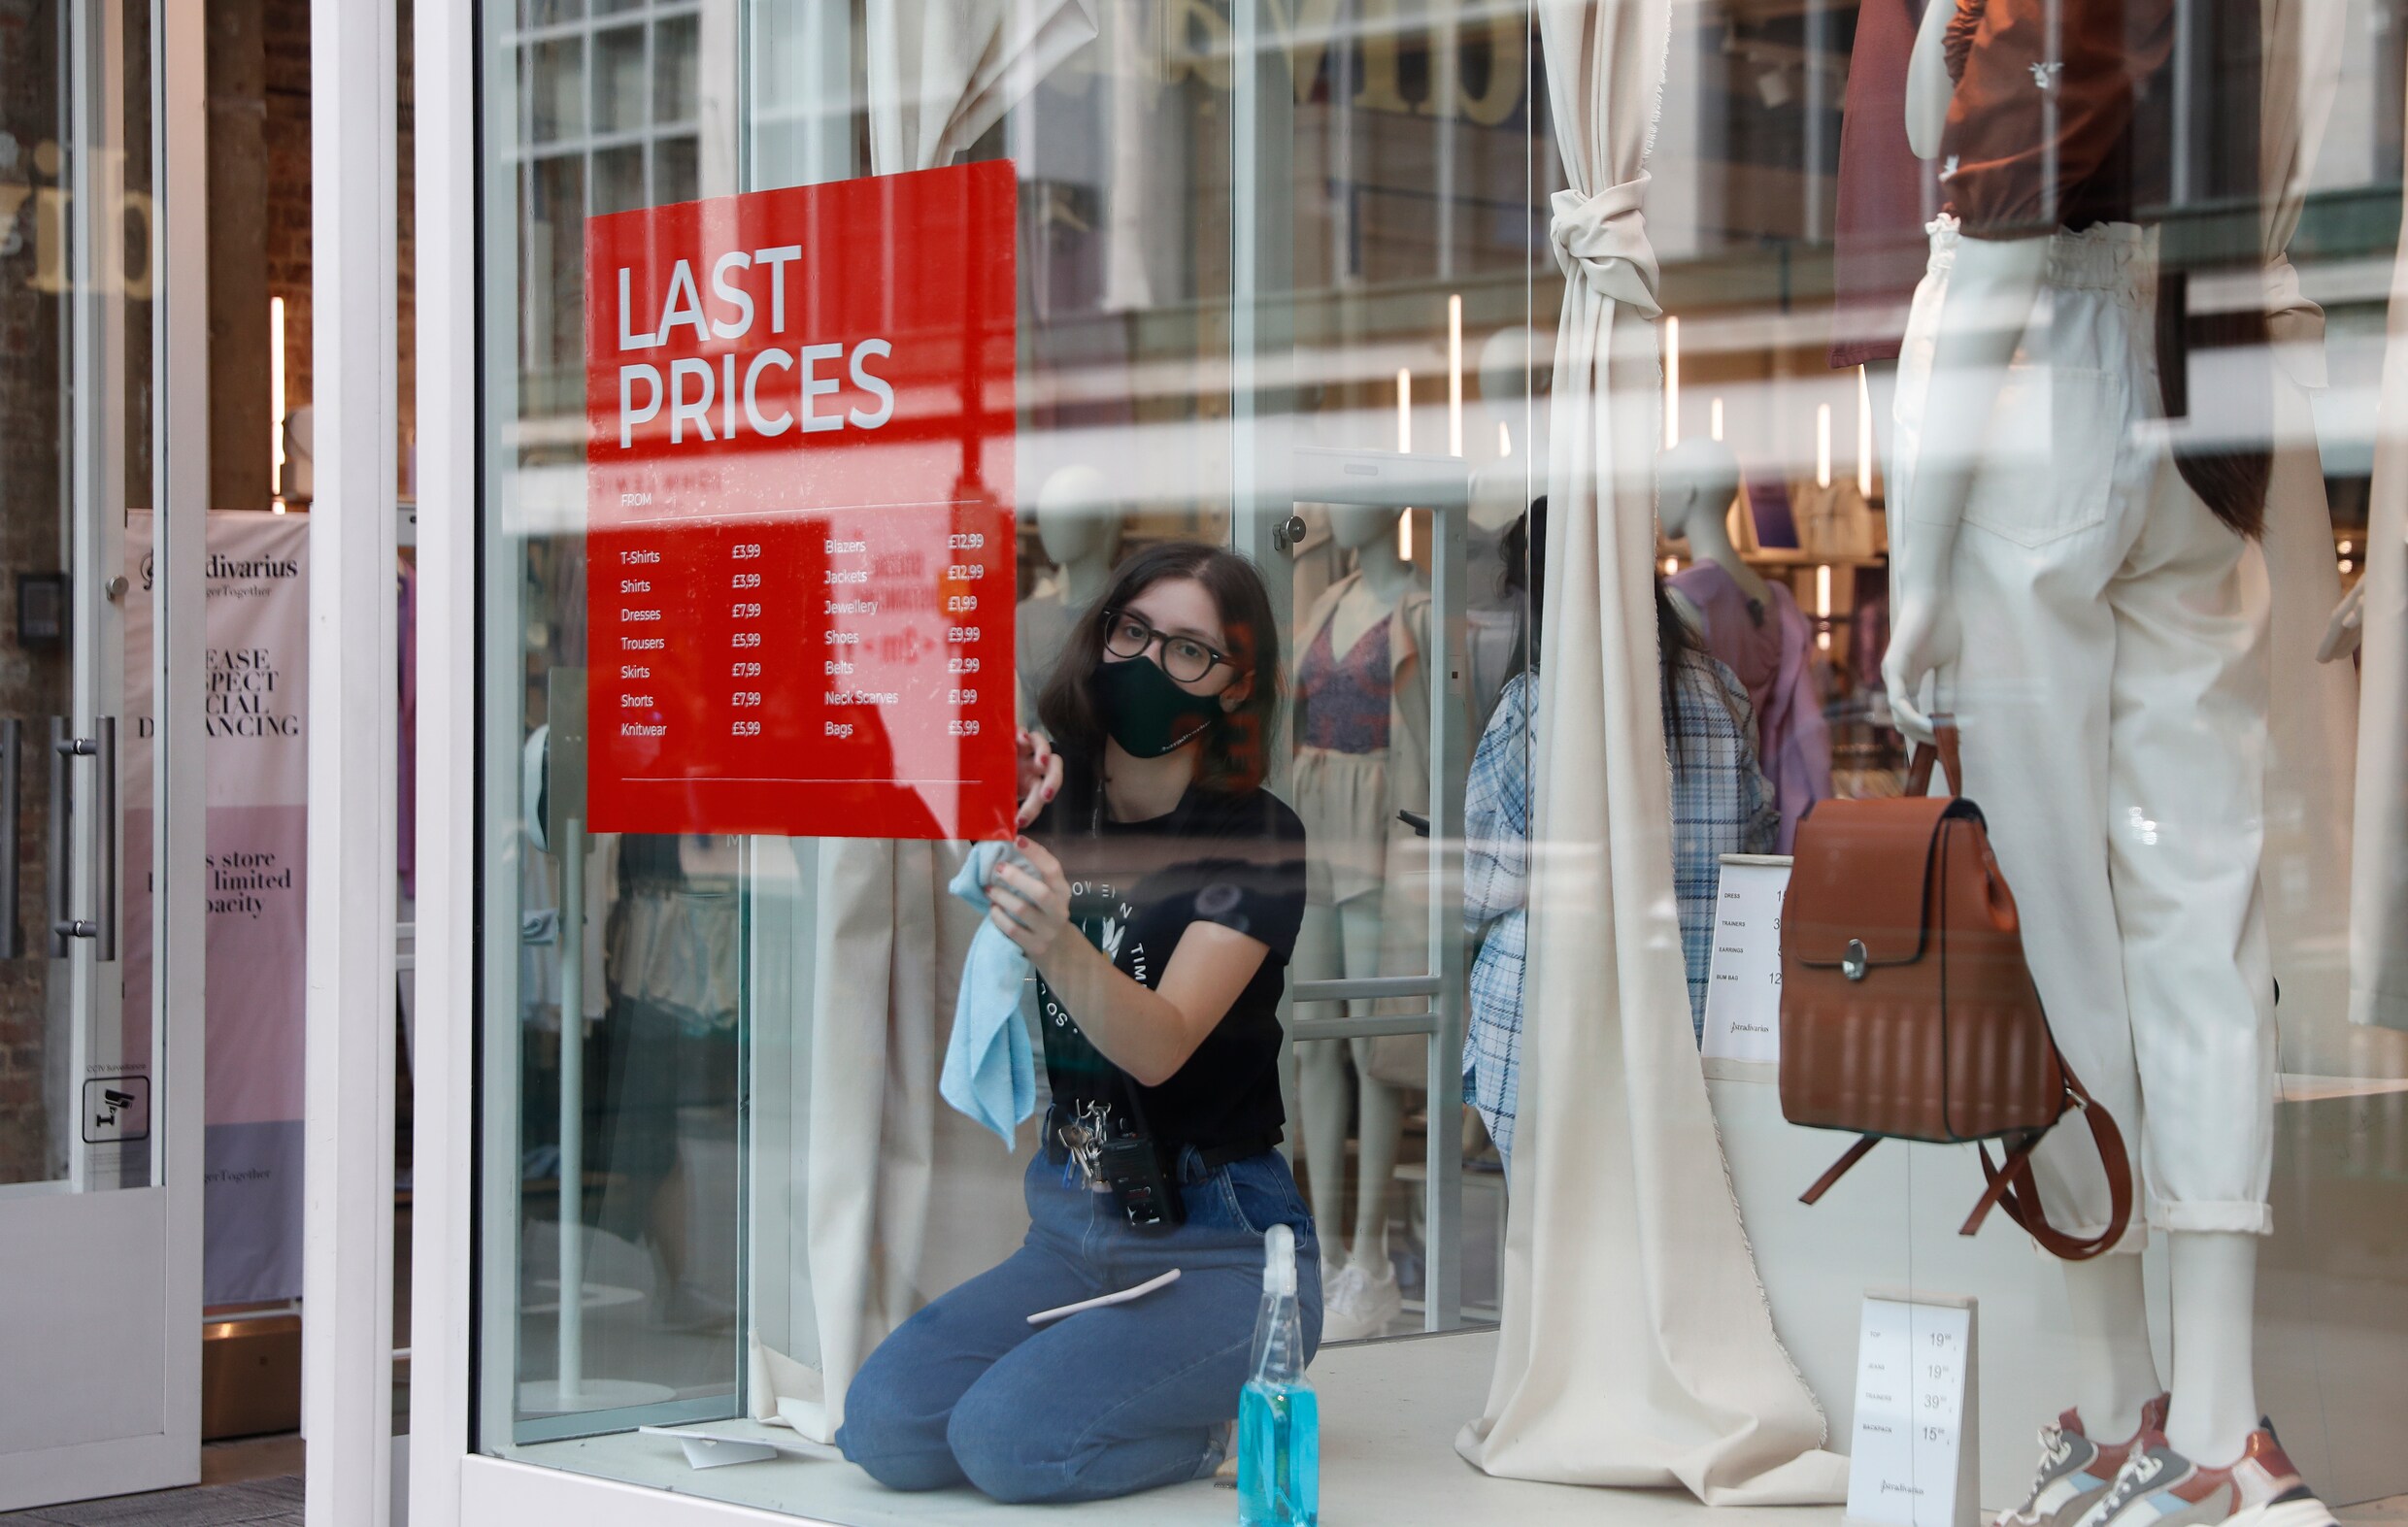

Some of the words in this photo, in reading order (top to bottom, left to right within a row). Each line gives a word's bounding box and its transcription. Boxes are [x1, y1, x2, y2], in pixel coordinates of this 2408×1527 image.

[619, 244, 802, 351] LAST
[619, 338, 895, 448] PRICES
[620, 492, 652, 508] FROM
[824, 540, 866, 554] Blazers
[948, 533, 984, 550] £12,99
[620, 549, 660, 564] T-Shirts
[732, 544, 761, 560] £3,99
[620, 579, 651, 593] Shirts
[732, 574, 761, 589] £3,99
[823, 570, 868, 584] Jackets
[948, 564, 984, 581] £12,99
[620, 609, 661, 622] Dresses
[732, 603, 761, 619] £7,99
[823, 599, 879, 614] Jewellery
[948, 595, 978, 613] £1,99
[620, 637, 665, 650] Trousers
[732, 633, 761, 648] £5,99
[824, 630, 859, 645] Shoes
[948, 626, 981, 644] £9,99
[206, 648, 271, 670] EASE
[824, 660, 853, 675] Belts
[948, 657, 980, 675] £2,99
[620, 664, 651, 679] Skirts
[732, 662, 761, 678] £7,99
[206, 671, 279, 692] PECT
[206, 694, 270, 714] CIAL
[620, 693, 653, 708] Shorts
[732, 692, 761, 708] £7,99
[824, 690, 854, 705] Neck
[855, 689, 898, 705] Scarves
[948, 688, 978, 706] £1,99
[139, 714, 299, 738] DNCING
[620, 722, 667, 736] Knitwear
[732, 721, 761, 737] £5,99
[824, 720, 853, 739] Bags
[948, 719, 980, 737] £5,99
[221, 850, 276, 869] store
[214, 869, 291, 892] limited
[205, 892, 266, 919] acity
[1072, 880, 1110, 898] OVE
[1130, 943, 1148, 988] TIM
